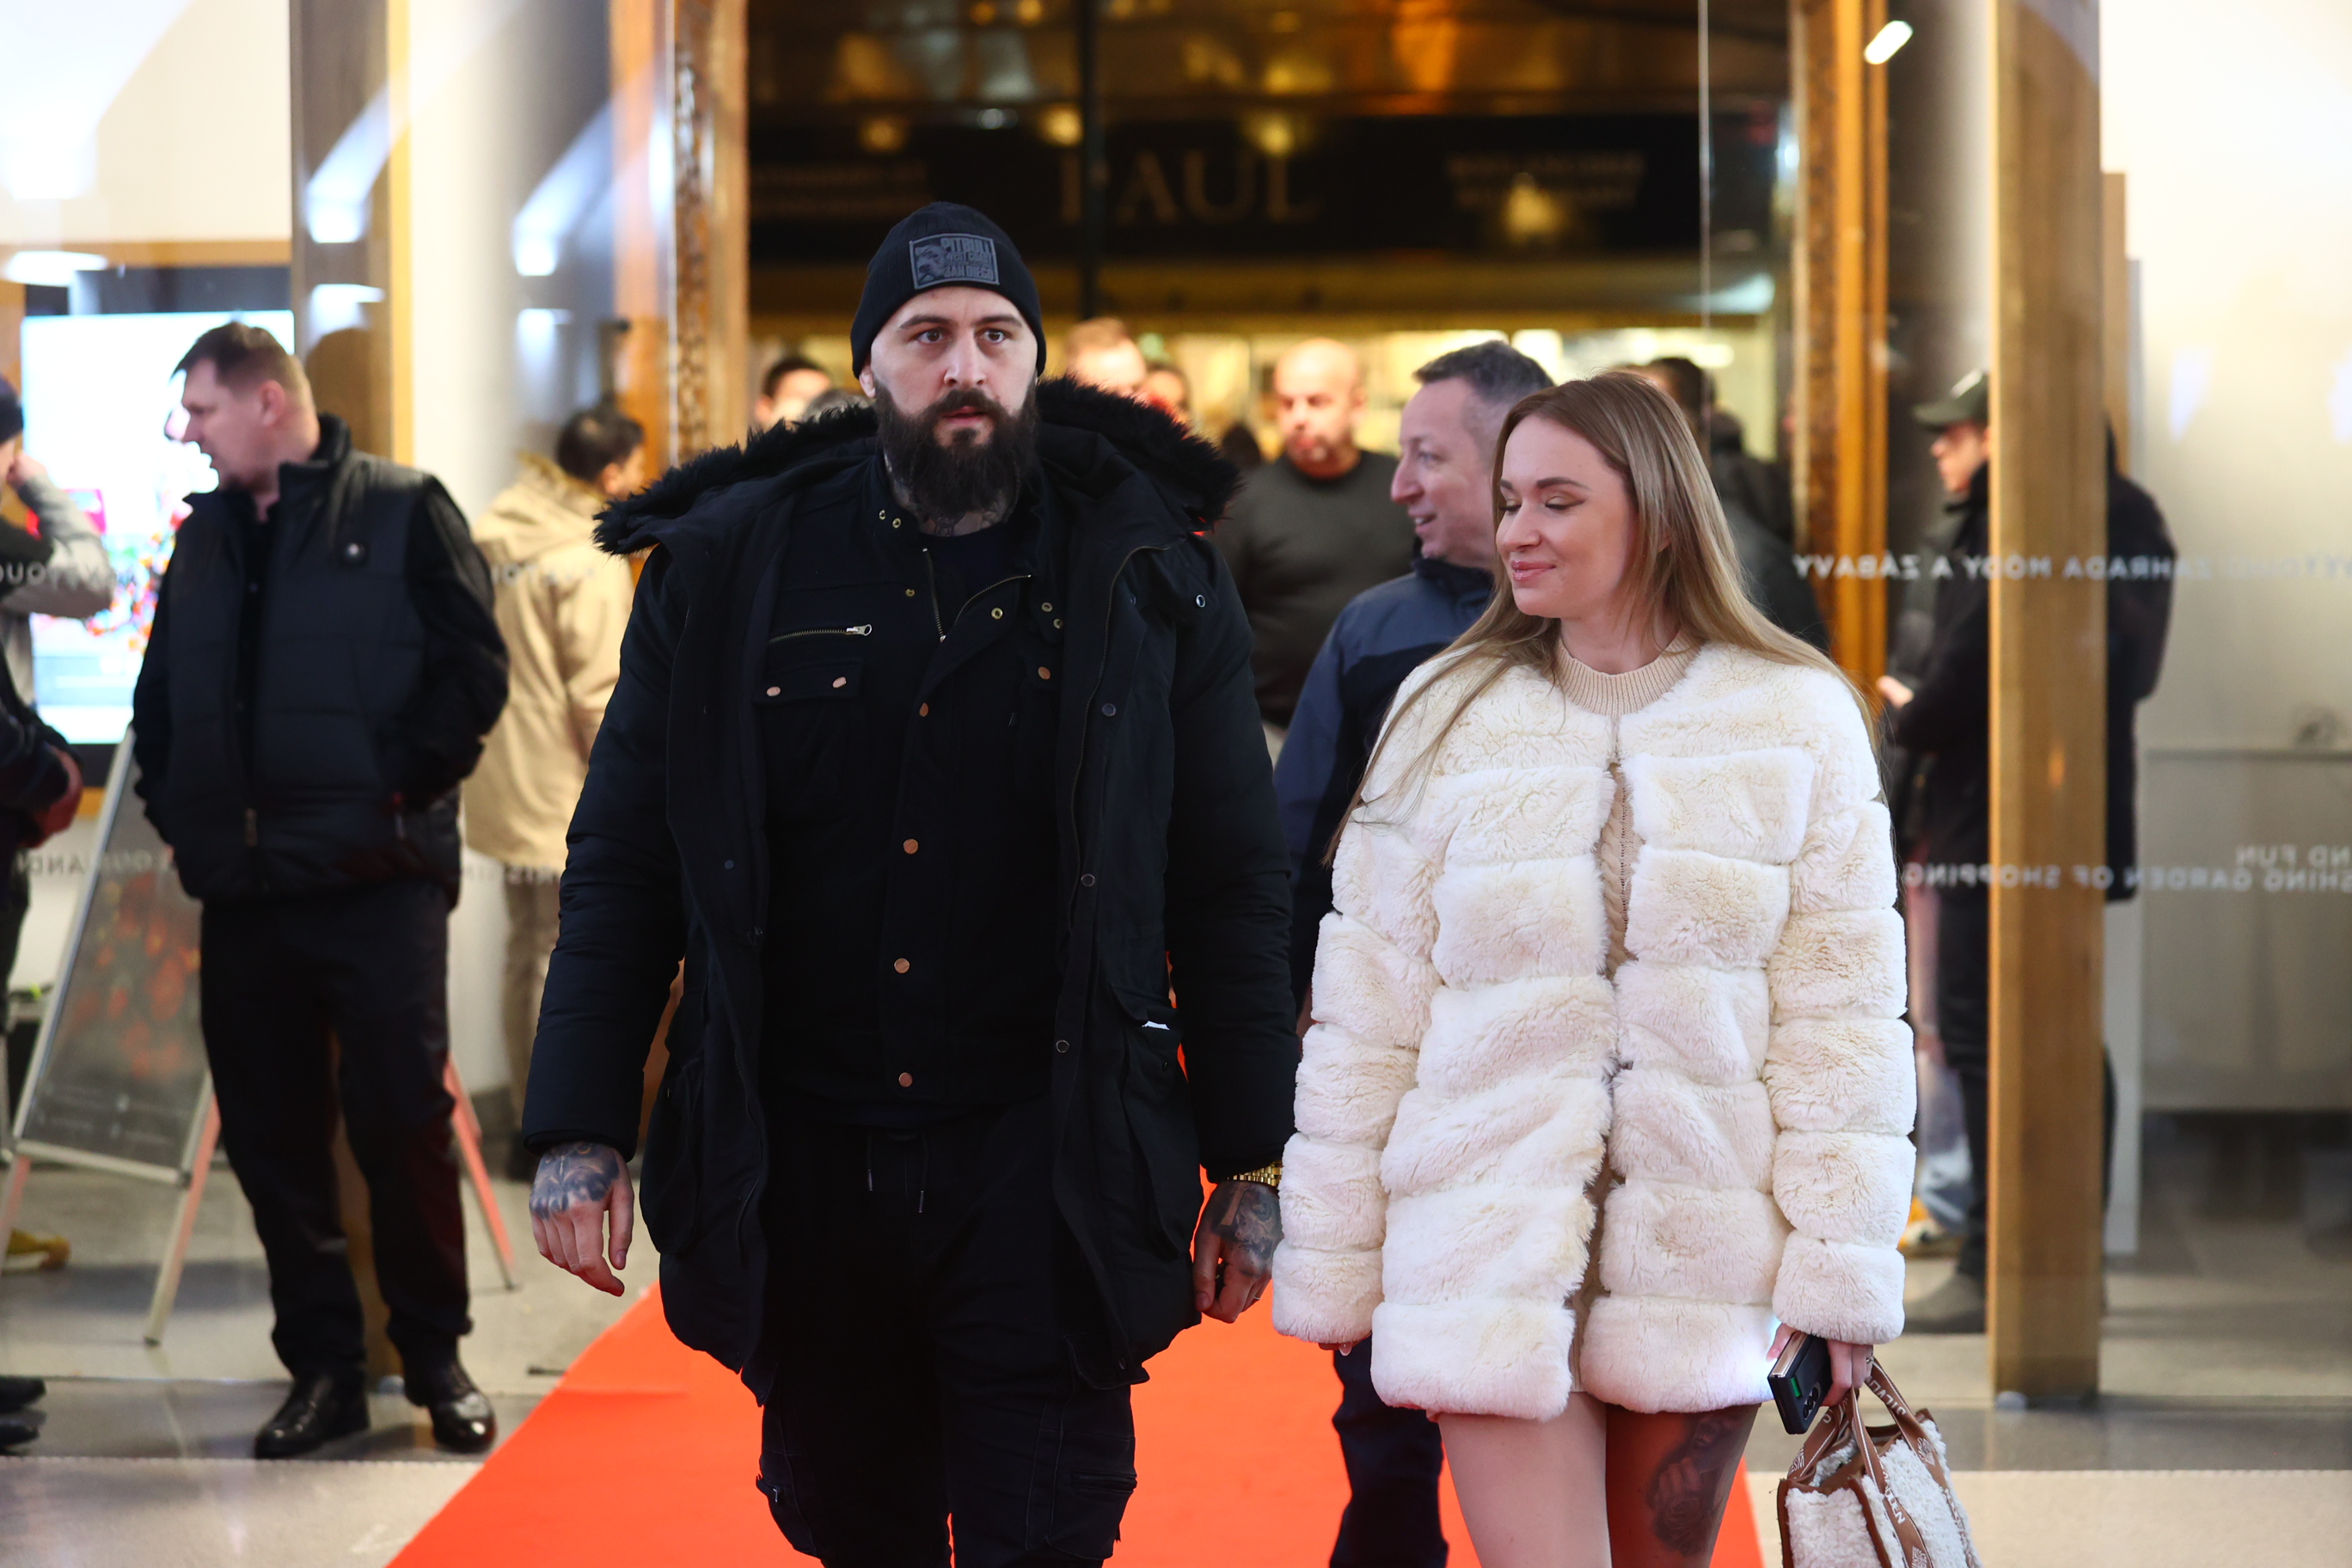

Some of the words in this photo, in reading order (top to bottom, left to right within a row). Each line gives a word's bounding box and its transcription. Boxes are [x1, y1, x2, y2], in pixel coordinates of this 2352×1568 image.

[940, 237, 993, 254] PITBULL
[944, 265, 965, 278] SAN
[965, 265, 995, 280] DIEGO
